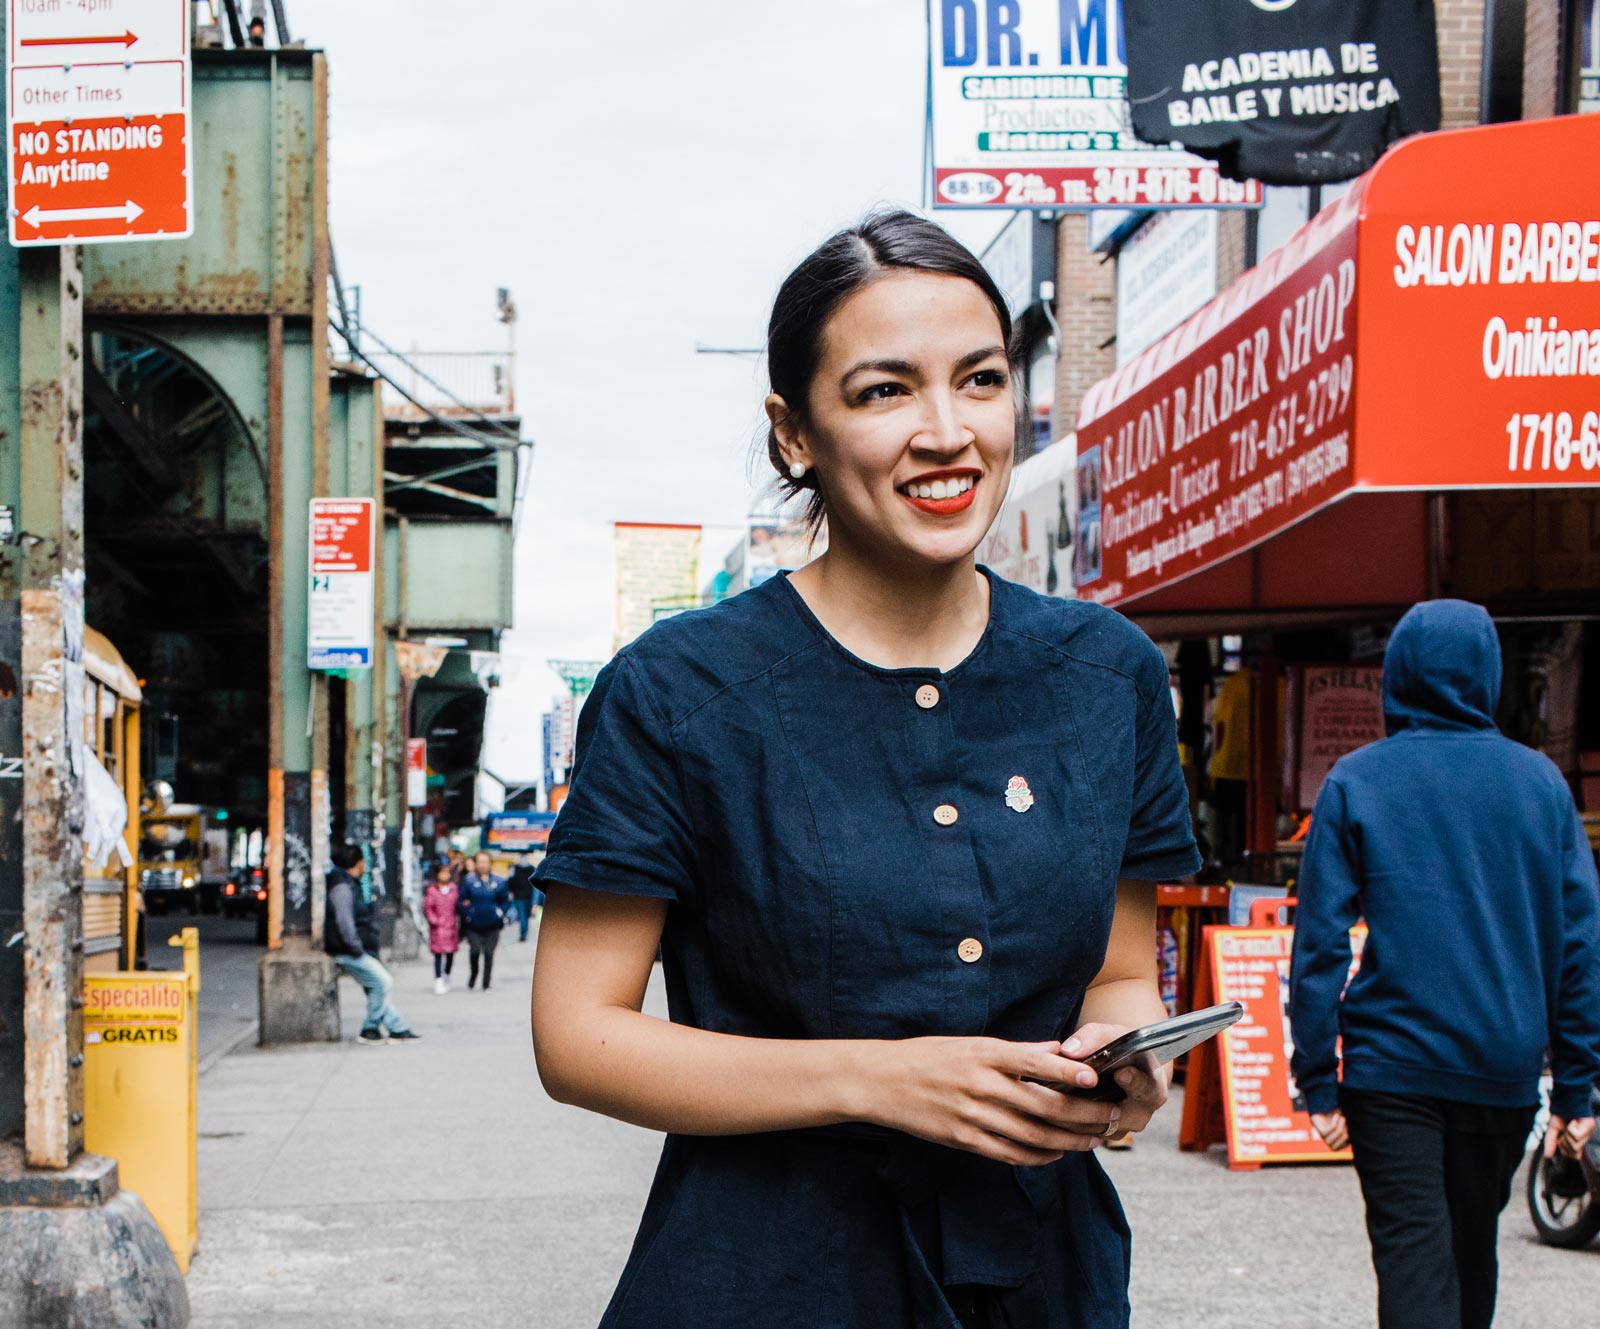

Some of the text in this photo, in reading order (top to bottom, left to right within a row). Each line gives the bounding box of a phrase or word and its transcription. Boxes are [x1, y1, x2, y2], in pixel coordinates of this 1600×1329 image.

[941, 0, 1127, 66] DR. M
[964, 76, 1091, 98] SABIDURIA
[1182, 43, 1378, 92] ACADEMIA DE
[23, 86, 122, 104] Other Times
[984, 102, 1096, 128] Productos
[1167, 77, 1400, 127] BAILE Y MUSICA
[19, 124, 162, 156] NO STANDING
[21, 159, 109, 188] Anytime
[1394, 220, 1600, 287] SALON BARBE
[1483, 315, 1600, 379] Onikiana
[1101, 397, 1170, 494] SALON
[1172, 326, 1270, 452] BARBER
[1277, 258, 1355, 383] SHOP
[1229, 353, 1353, 482] 718-651-2799
[1506, 410, 1600, 471] 1718-6
[103, 1029, 177, 1042] GRATIS
